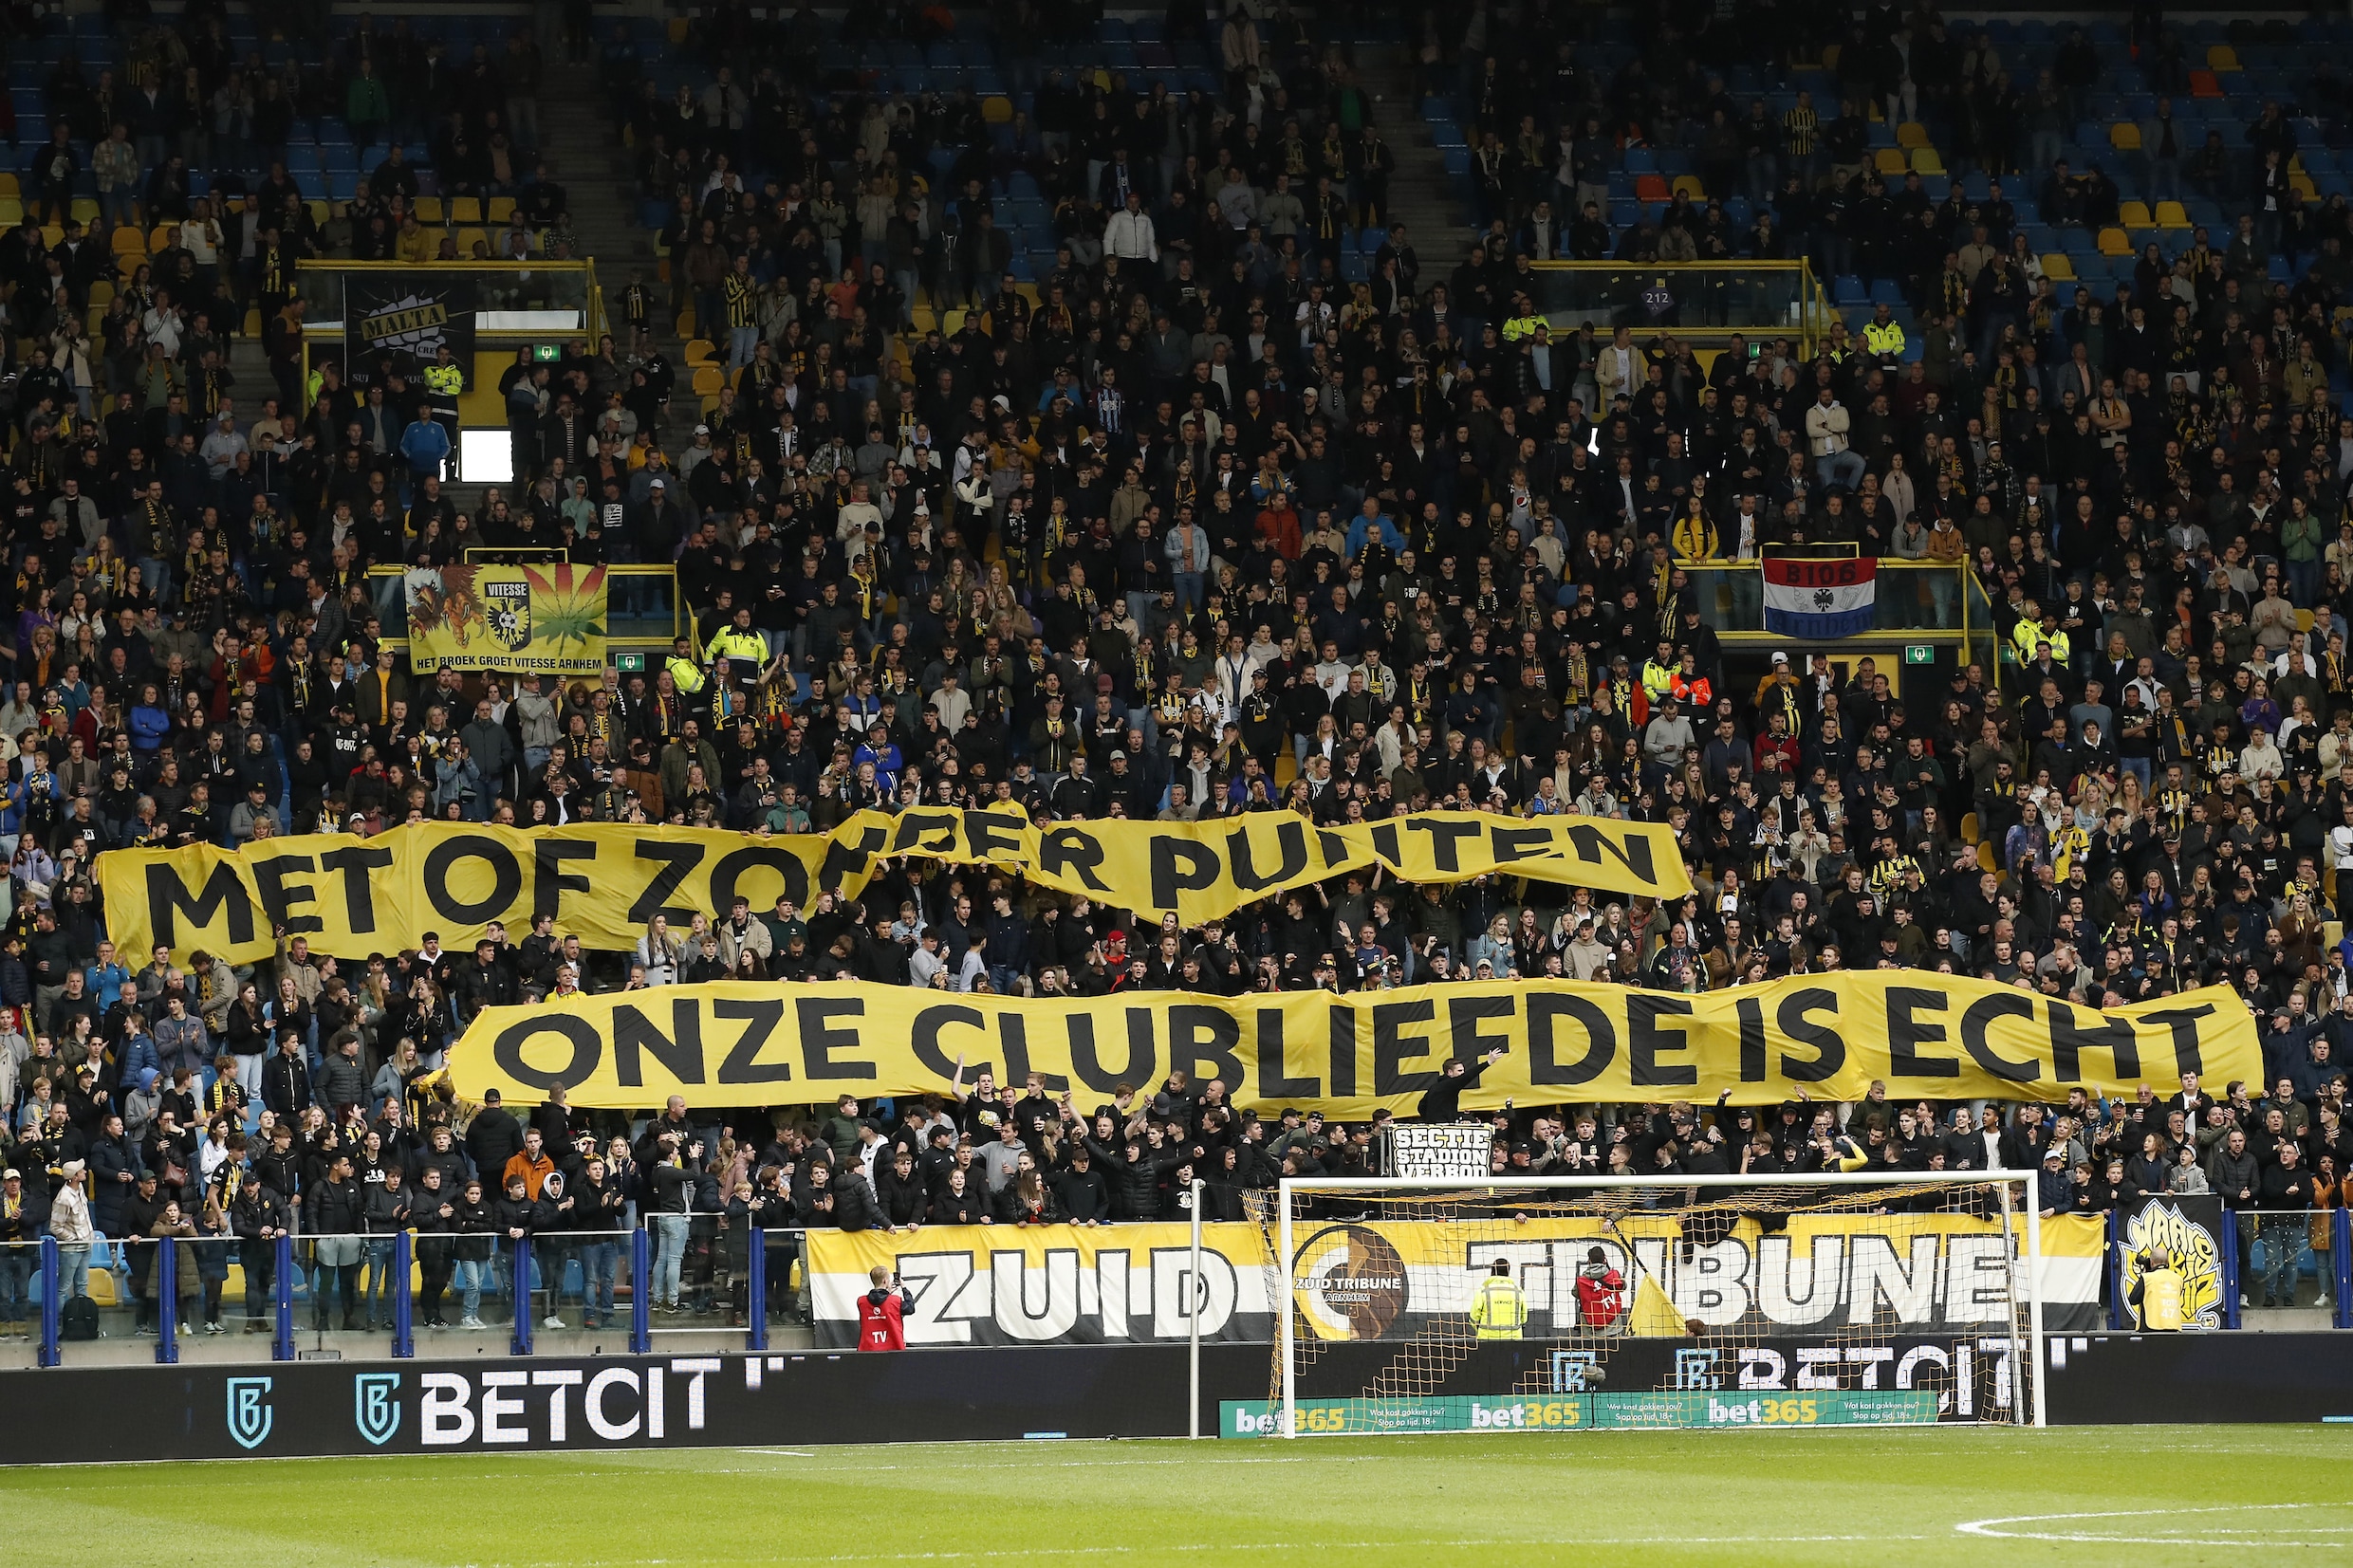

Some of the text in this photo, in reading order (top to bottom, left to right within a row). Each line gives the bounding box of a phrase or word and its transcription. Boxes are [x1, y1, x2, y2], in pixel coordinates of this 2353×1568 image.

[1646, 292, 1669, 304] 212
[364, 307, 442, 339] MALTA
[417, 345, 437, 355] CRE
[1786, 561, 1857, 585] B106
[488, 583, 528, 597] VITESSE
[417, 655, 602, 670] HET BROEK GROET VITESSE ARNHEM
[145, 846, 393, 950] MET
[423, 836, 597, 926] OF
[494, 986, 2214, 1098] ONZE CLUBLIEFDE IS ECHT
[1395, 1128, 1491, 1149] SECTIE
[1397, 1148, 1488, 1165] STADION
[1398, 1164, 1488, 1178] VERBOD
[1294, 1277, 1401, 1290] ZUID TRIBUNE
[896, 1247, 1239, 1343] ZUID
[1325, 1292, 1371, 1302] ARNHEM
[1601, 1292, 1616, 1310] TV
[871, 1330, 888, 1344] TV
[1472, 1402, 1580, 1428] bet365
[1708, 1397, 1818, 1423] bet365
